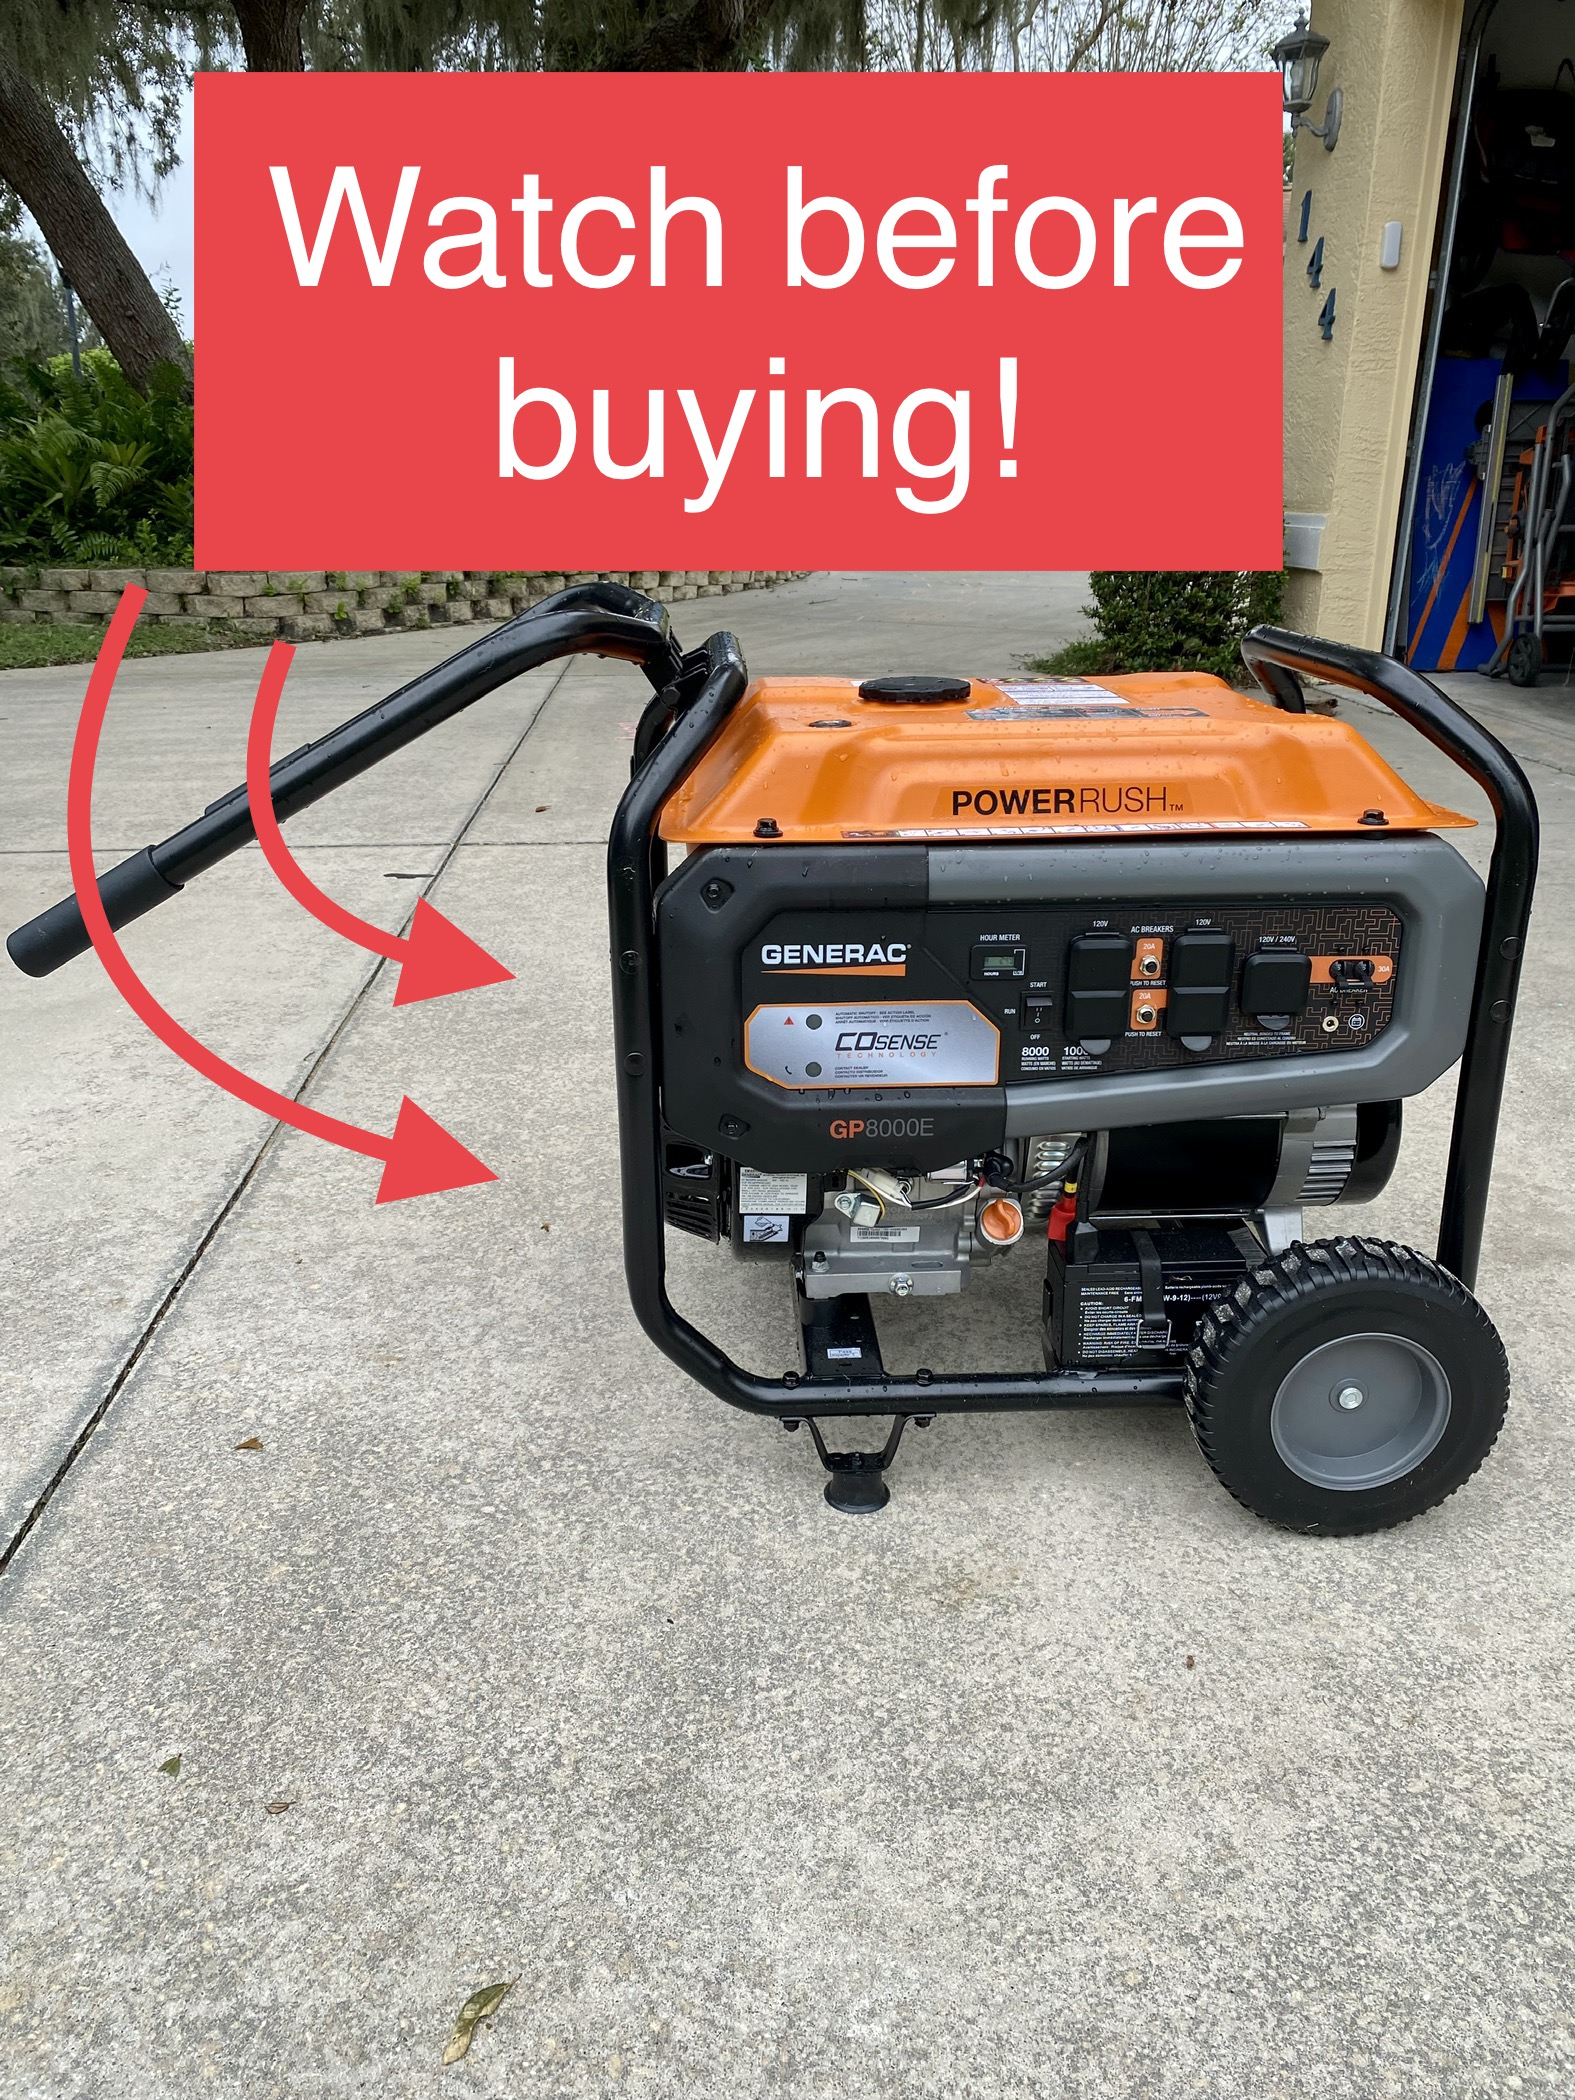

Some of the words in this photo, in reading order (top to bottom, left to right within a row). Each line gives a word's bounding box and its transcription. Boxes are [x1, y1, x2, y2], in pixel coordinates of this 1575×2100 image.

[761, 943, 906, 965] GENERAC
[837, 1051, 937, 1059] TECHNOLOGY
[1021, 1046, 1050, 1056] 8000
[1063, 1046, 1089, 1055] 100
[829, 1118, 934, 1139] GP8000E
